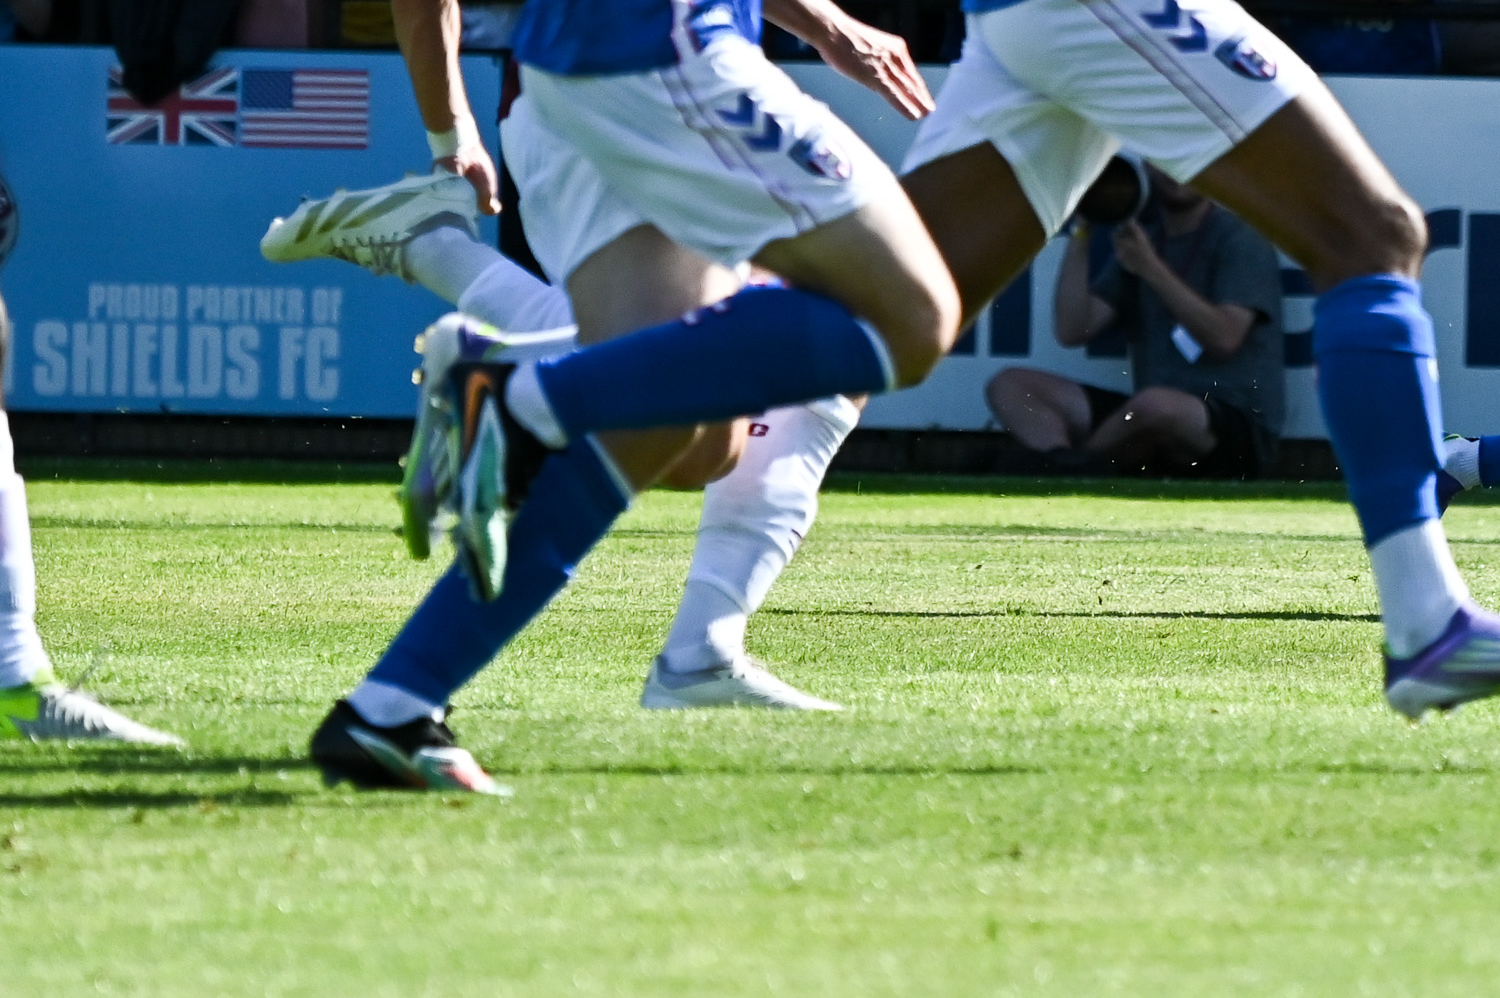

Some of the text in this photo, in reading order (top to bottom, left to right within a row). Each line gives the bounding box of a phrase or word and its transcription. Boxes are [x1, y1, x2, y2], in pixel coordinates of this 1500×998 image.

[88, 283, 343, 324] PROUD PARTNER OF
[34, 322, 260, 399] SHIELDS
[280, 327, 339, 402] FC
